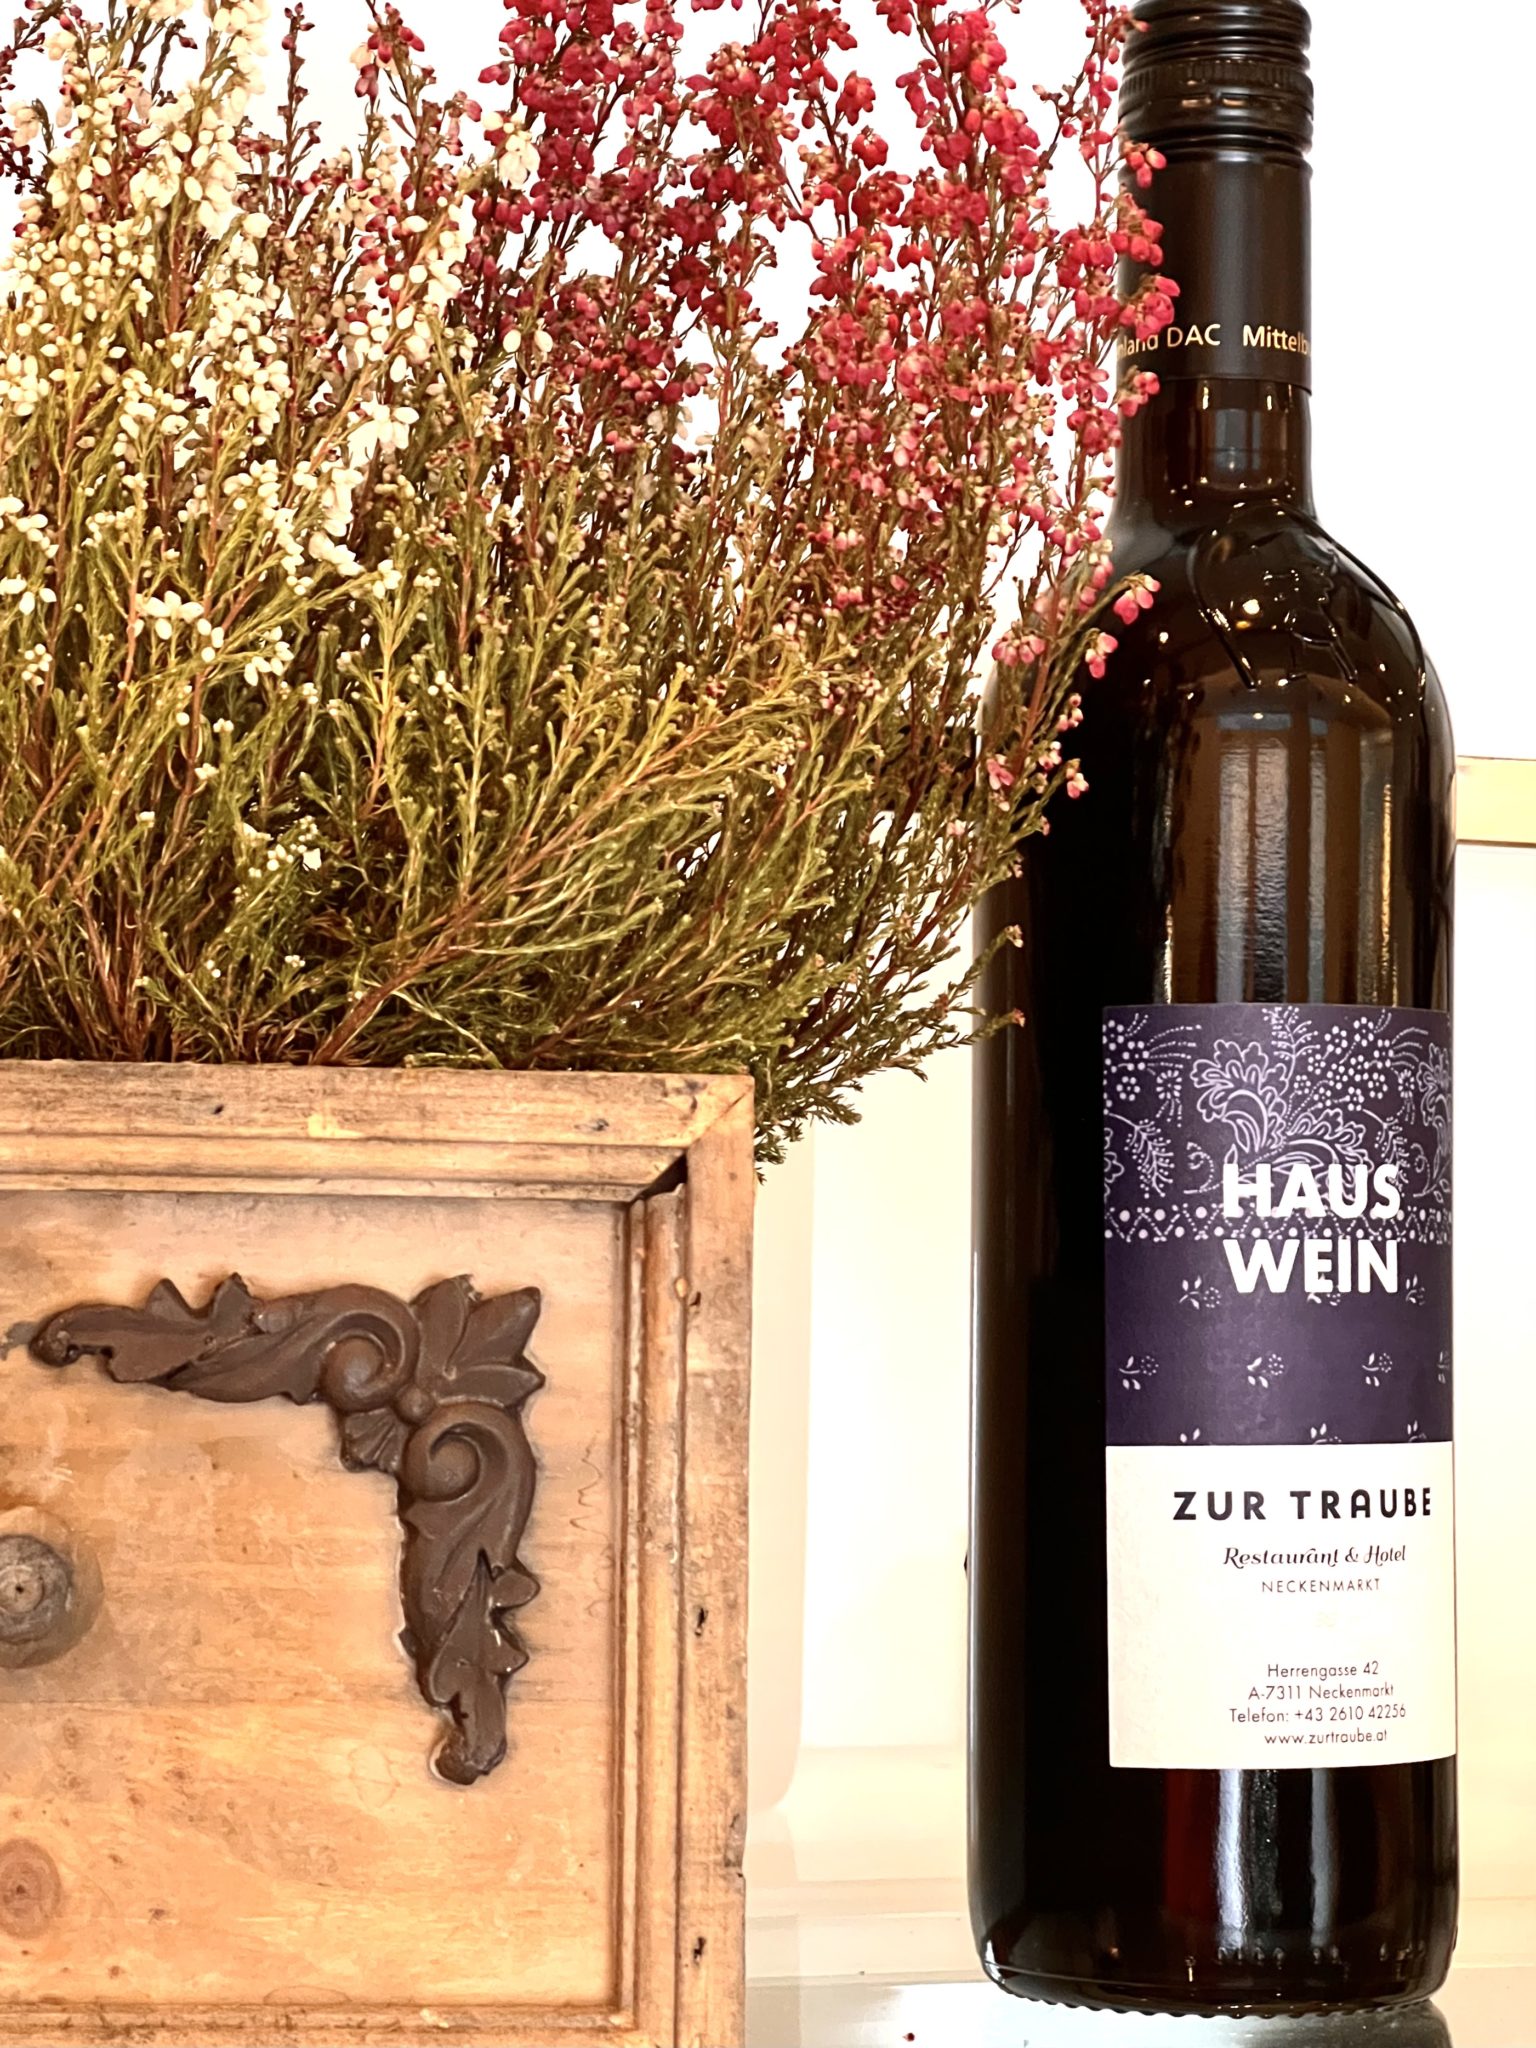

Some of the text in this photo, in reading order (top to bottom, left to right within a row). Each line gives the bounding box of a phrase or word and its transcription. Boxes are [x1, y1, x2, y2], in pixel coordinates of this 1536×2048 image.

[1166, 323, 1222, 348] DAC
[1222, 1163, 1402, 1220] HAUS
[1222, 1239, 1399, 1294] WEIN
[1172, 1487, 1432, 1521] ZUR TRAUBE
[1223, 1544, 1407, 1569] Restaurant & Hotel
[1261, 1578, 1381, 1594] NECKENMARKT
[1267, 1660, 1380, 1681] Herrengasse 42
[1248, 1682, 1394, 1701] A-7311 Neckenmarkt
[1229, 1703, 1407, 1723] Telefon: +43 2610 42256
[1264, 1728, 1388, 1745] www.zurtraube.at
